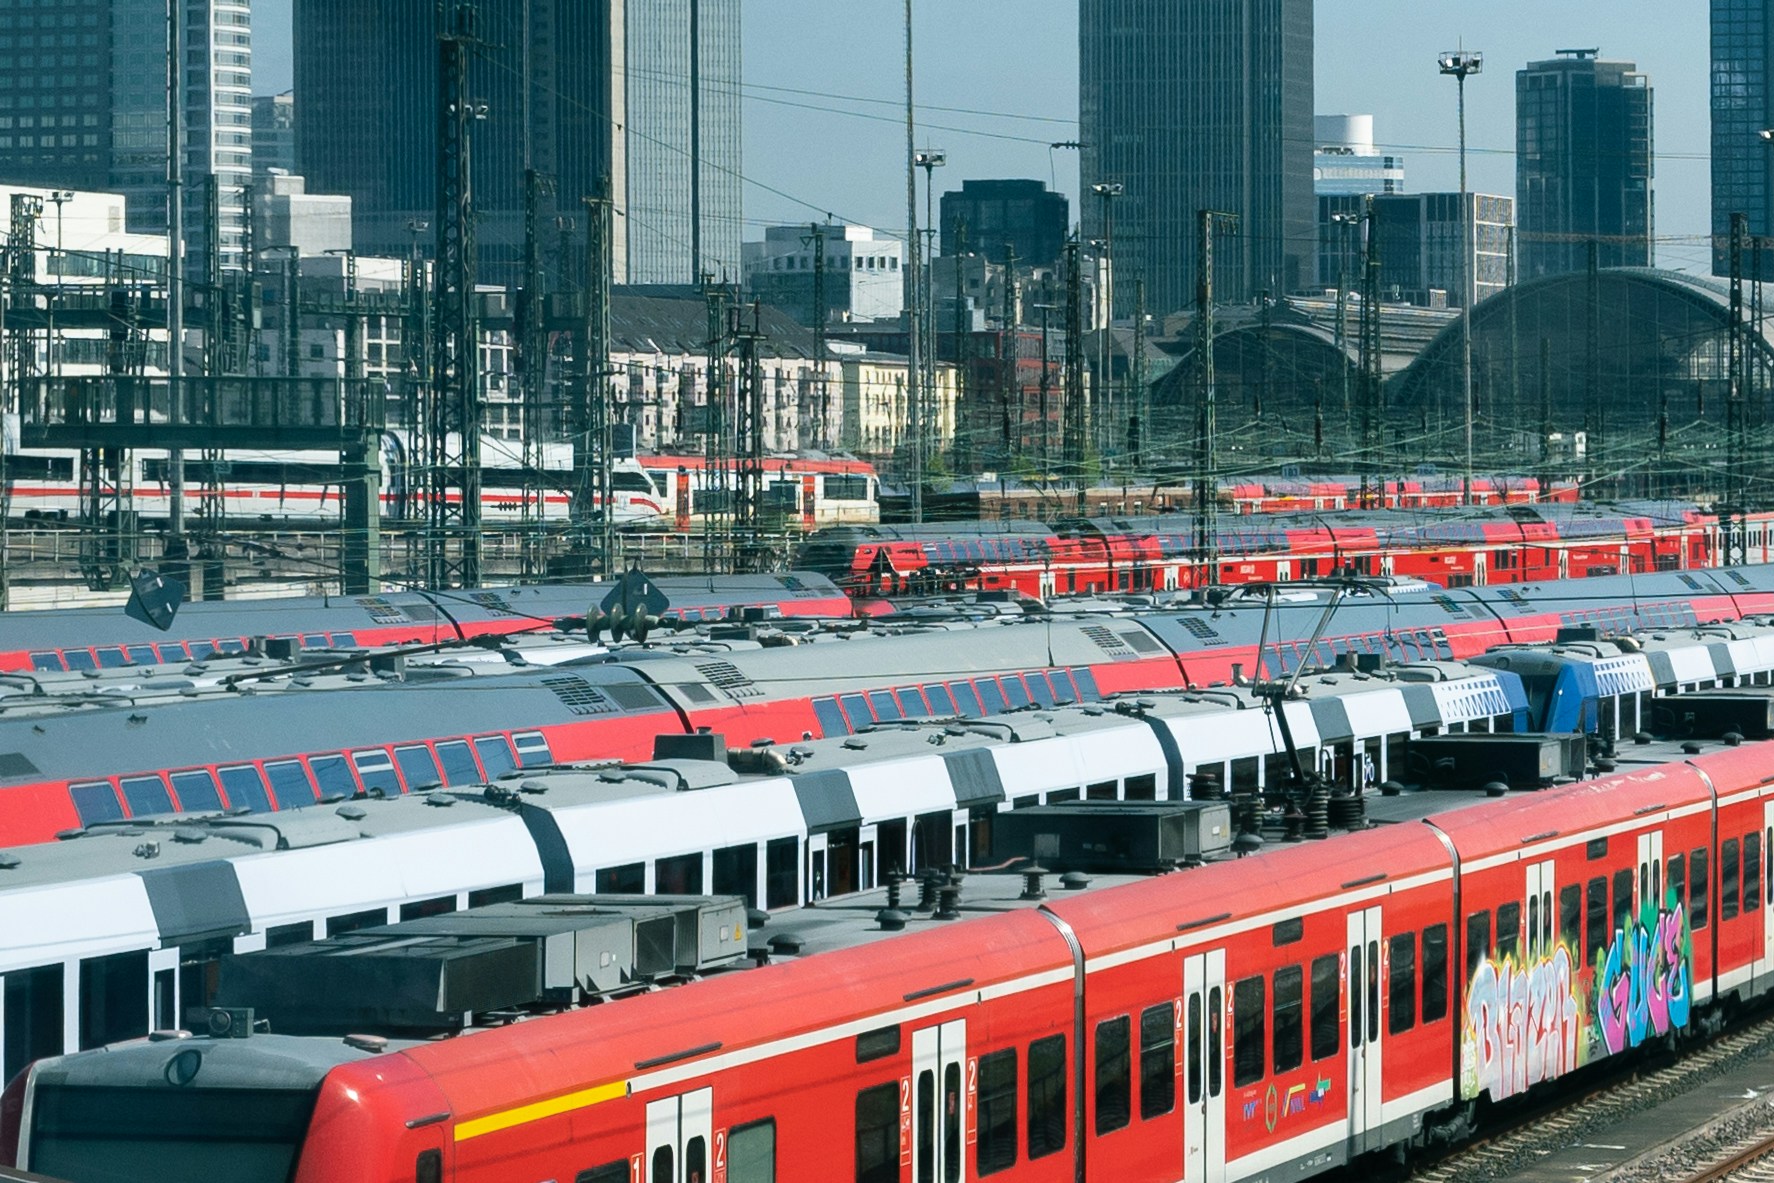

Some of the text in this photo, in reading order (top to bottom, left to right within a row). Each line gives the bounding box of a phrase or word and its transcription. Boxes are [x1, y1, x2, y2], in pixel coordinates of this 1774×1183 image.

[1176, 999, 1182, 1028] 2
[1227, 984, 1233, 1013] 2
[968, 1060, 976, 1091] 2
[902, 1079, 910, 1112] 2
[716, 1132, 724, 1168] 2
[633, 1157, 640, 1183] 1
